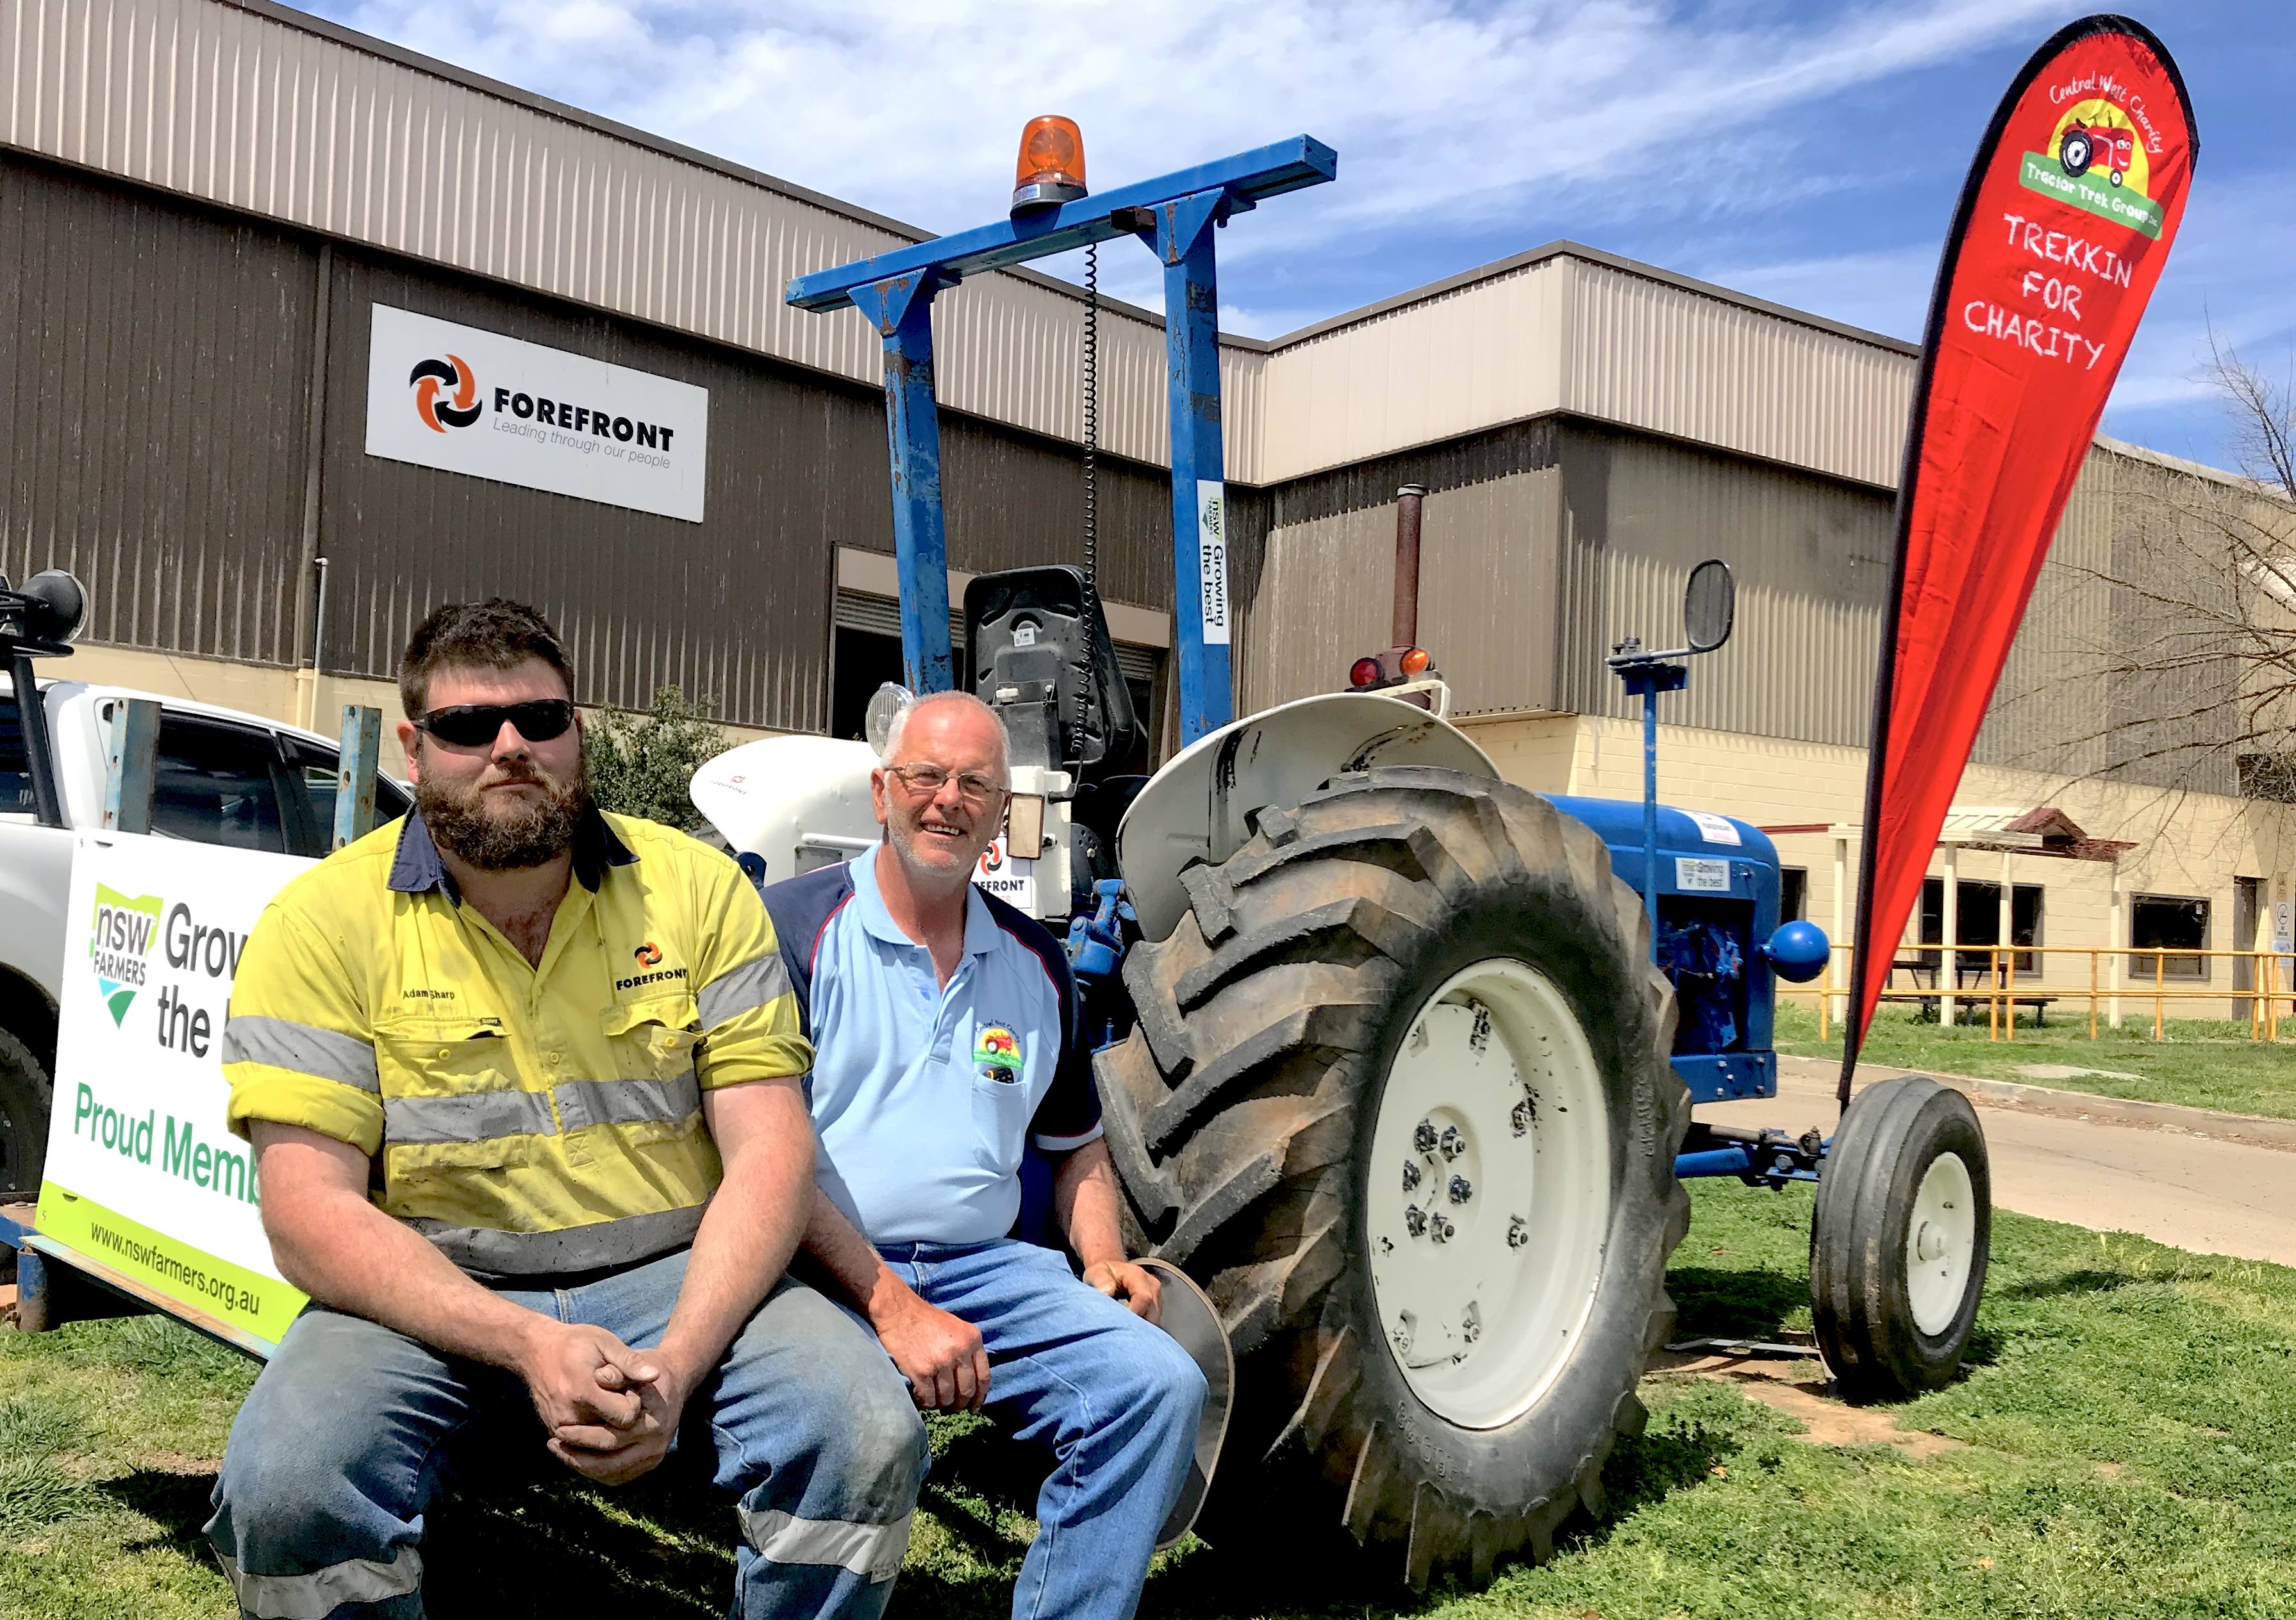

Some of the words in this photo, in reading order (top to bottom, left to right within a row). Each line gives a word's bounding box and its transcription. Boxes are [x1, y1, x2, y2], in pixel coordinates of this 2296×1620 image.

[2050, 70, 2096, 104] Central
[2099, 75, 2127, 102] West
[2129, 95, 2163, 153] Charity
[2027, 161, 2077, 194] Tractor
[2079, 183, 2108, 209] Trek
[2003, 213, 2133, 288] TREKKIN
[2022, 270, 2082, 321] FOR
[1964, 301, 2106, 370] CHARITY
[493, 417, 545, 443] Leading
[551, 429, 600, 454] through
[604, 446, 626, 459] our
[628, 449, 670, 469] people
[494, 386, 674, 452] FOREFRONT
[1202, 545, 1211, 575] the
[1213, 545, 1225, 627] Growing
[1204, 582, 1214, 624] best
[96, 908, 151, 955] nsw
[93, 950, 146, 986] FARMERS
[616, 968, 687, 991] FOREFRONT
[403, 989, 429, 1000] Adam
[429, 989, 455, 1000] Sharp
[157, 984, 211, 1059] the
[74, 1081, 155, 1165] Proud
[91, 1221, 260, 1316] www.nswfarmers.org.au
